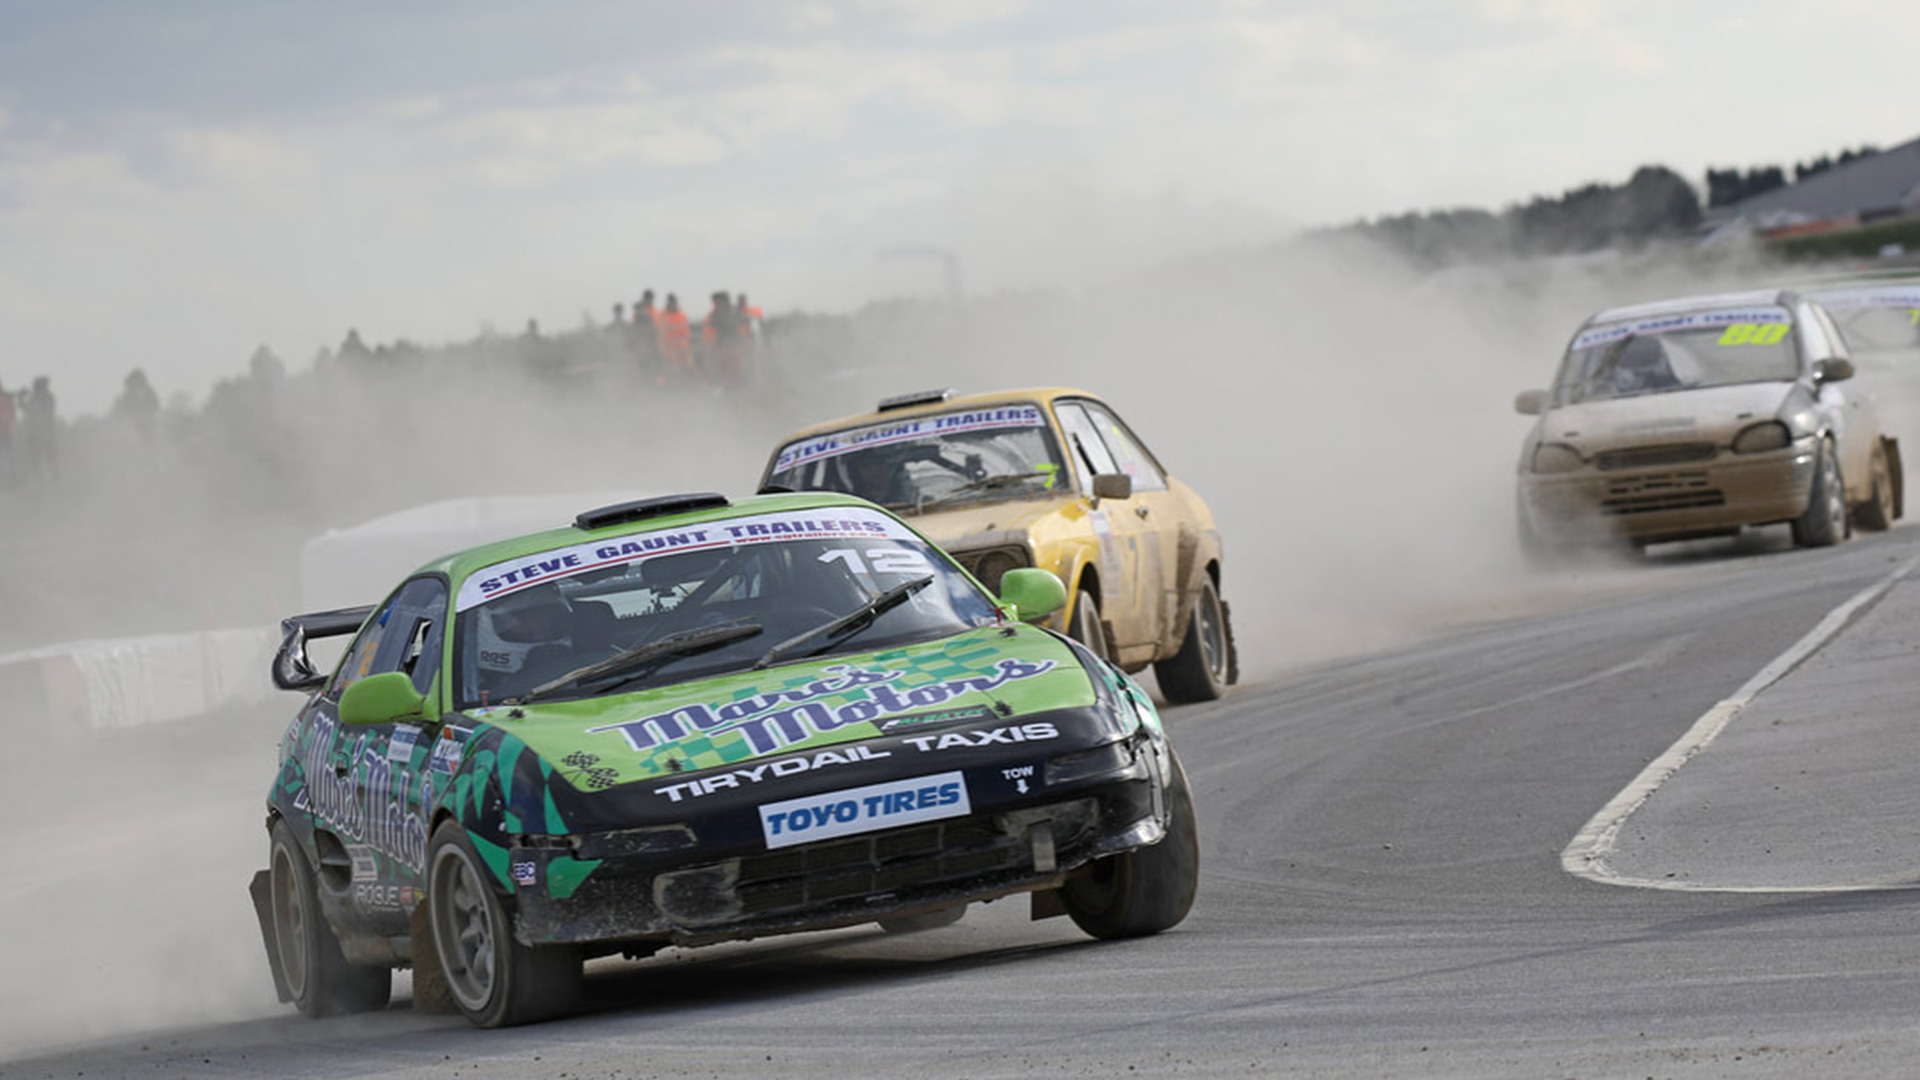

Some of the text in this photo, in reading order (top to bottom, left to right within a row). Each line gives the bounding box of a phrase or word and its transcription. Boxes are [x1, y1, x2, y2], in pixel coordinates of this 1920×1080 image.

[1717, 323, 1791, 346] 80
[778, 439, 838, 465] STEVE
[934, 408, 1038, 430] TRAILERS
[1034, 463, 1061, 488] 7
[479, 520, 886, 594] STEVE GAUNT TRAILERS
[817, 548, 934, 574] 12
[584, 663, 905, 751] Marc's
[705, 657, 1058, 757] Motors
[653, 722, 1060, 803] TIRYDAIL TAXIS
[1001, 765, 1034, 780] TOW
[766, 781, 961, 836] TOYO TIRES
